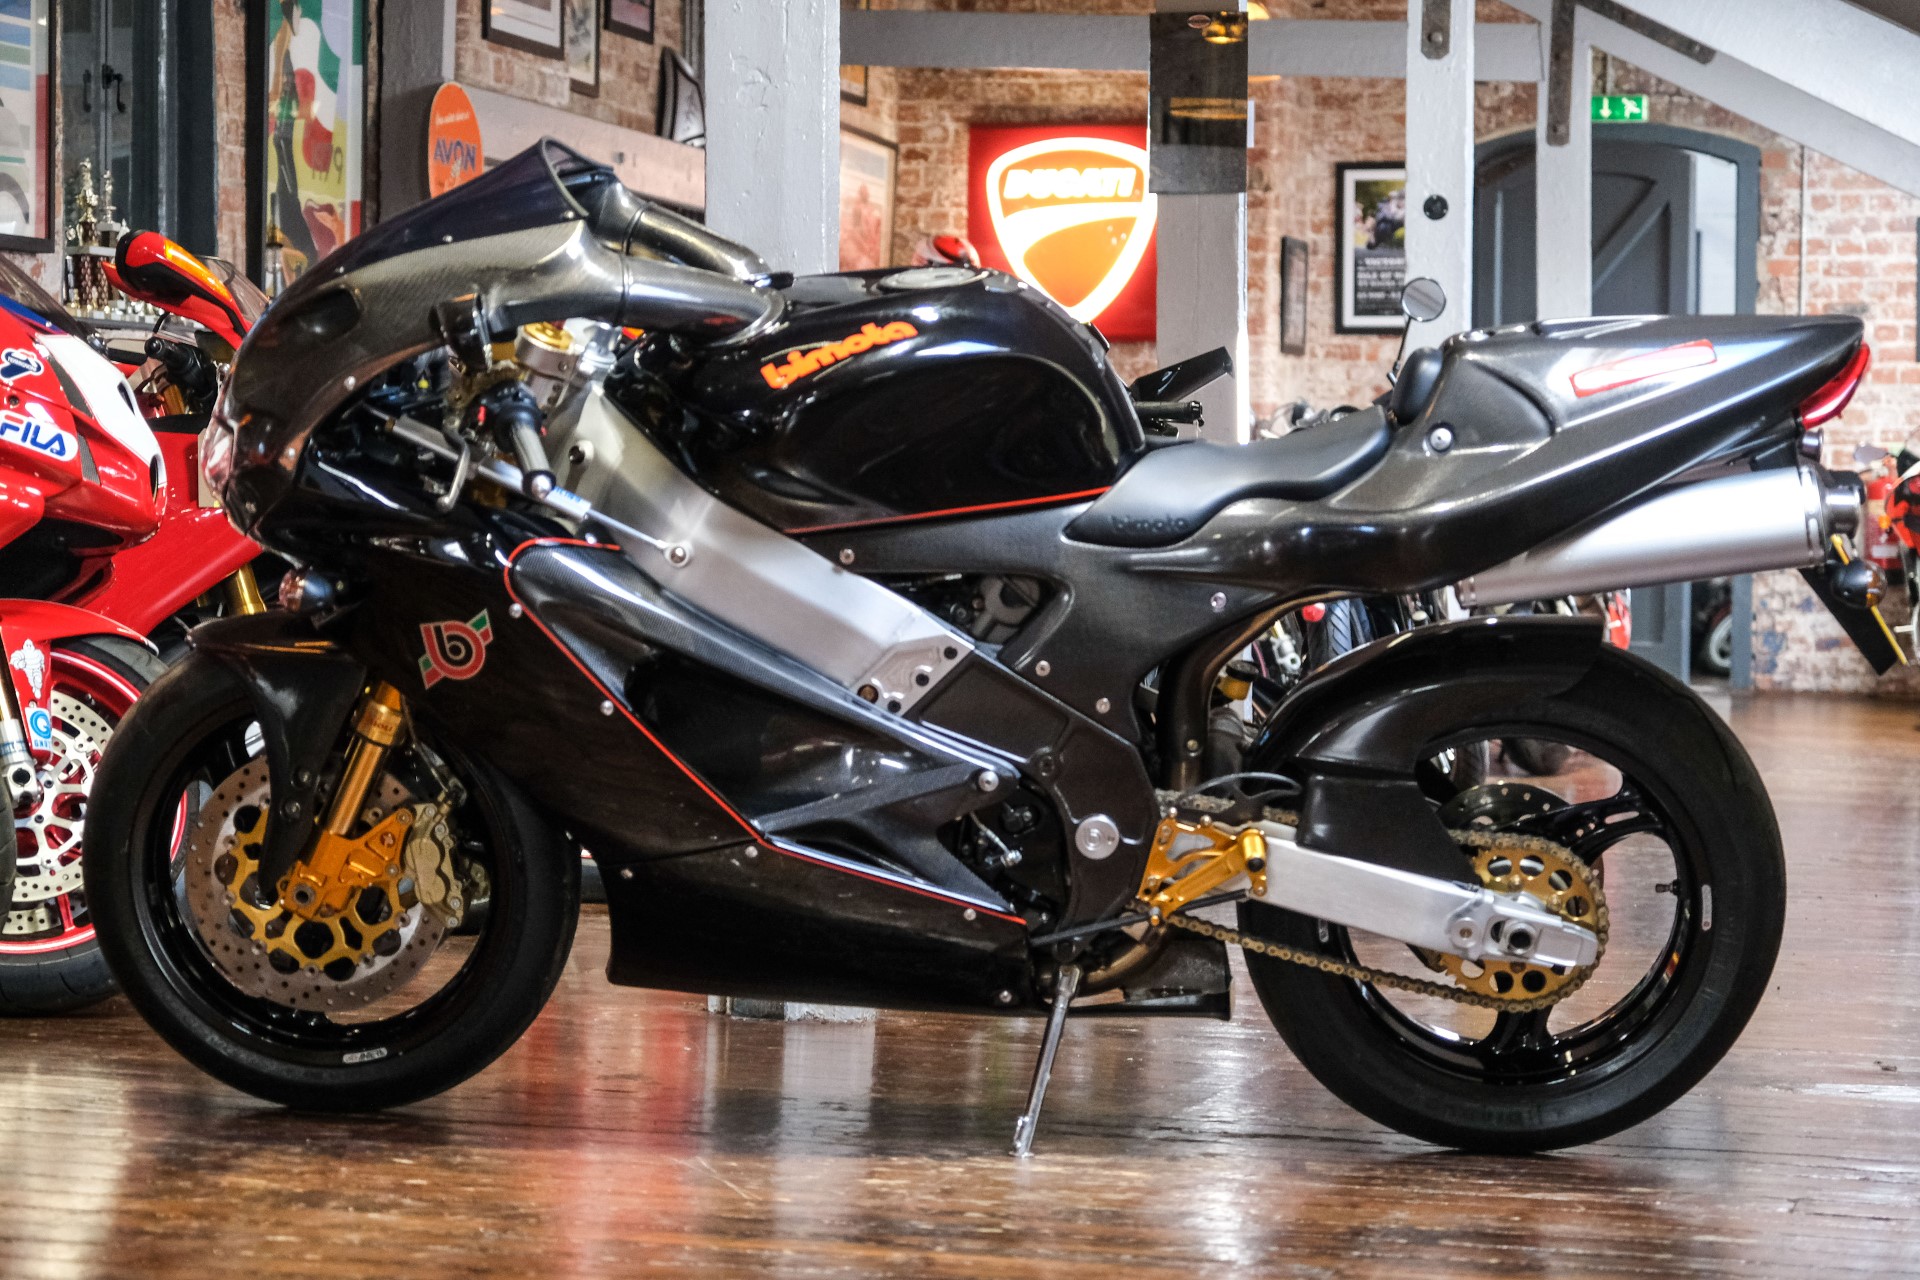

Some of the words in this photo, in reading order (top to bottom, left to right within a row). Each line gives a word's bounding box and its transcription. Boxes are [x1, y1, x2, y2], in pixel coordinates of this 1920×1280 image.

[433, 137, 477, 171] AVON
[1003, 167, 1137, 199] DUCATI
[760, 321, 919, 389] bimota
[0, 413, 66, 457] FILA
[1110, 512, 1186, 533] bimota
